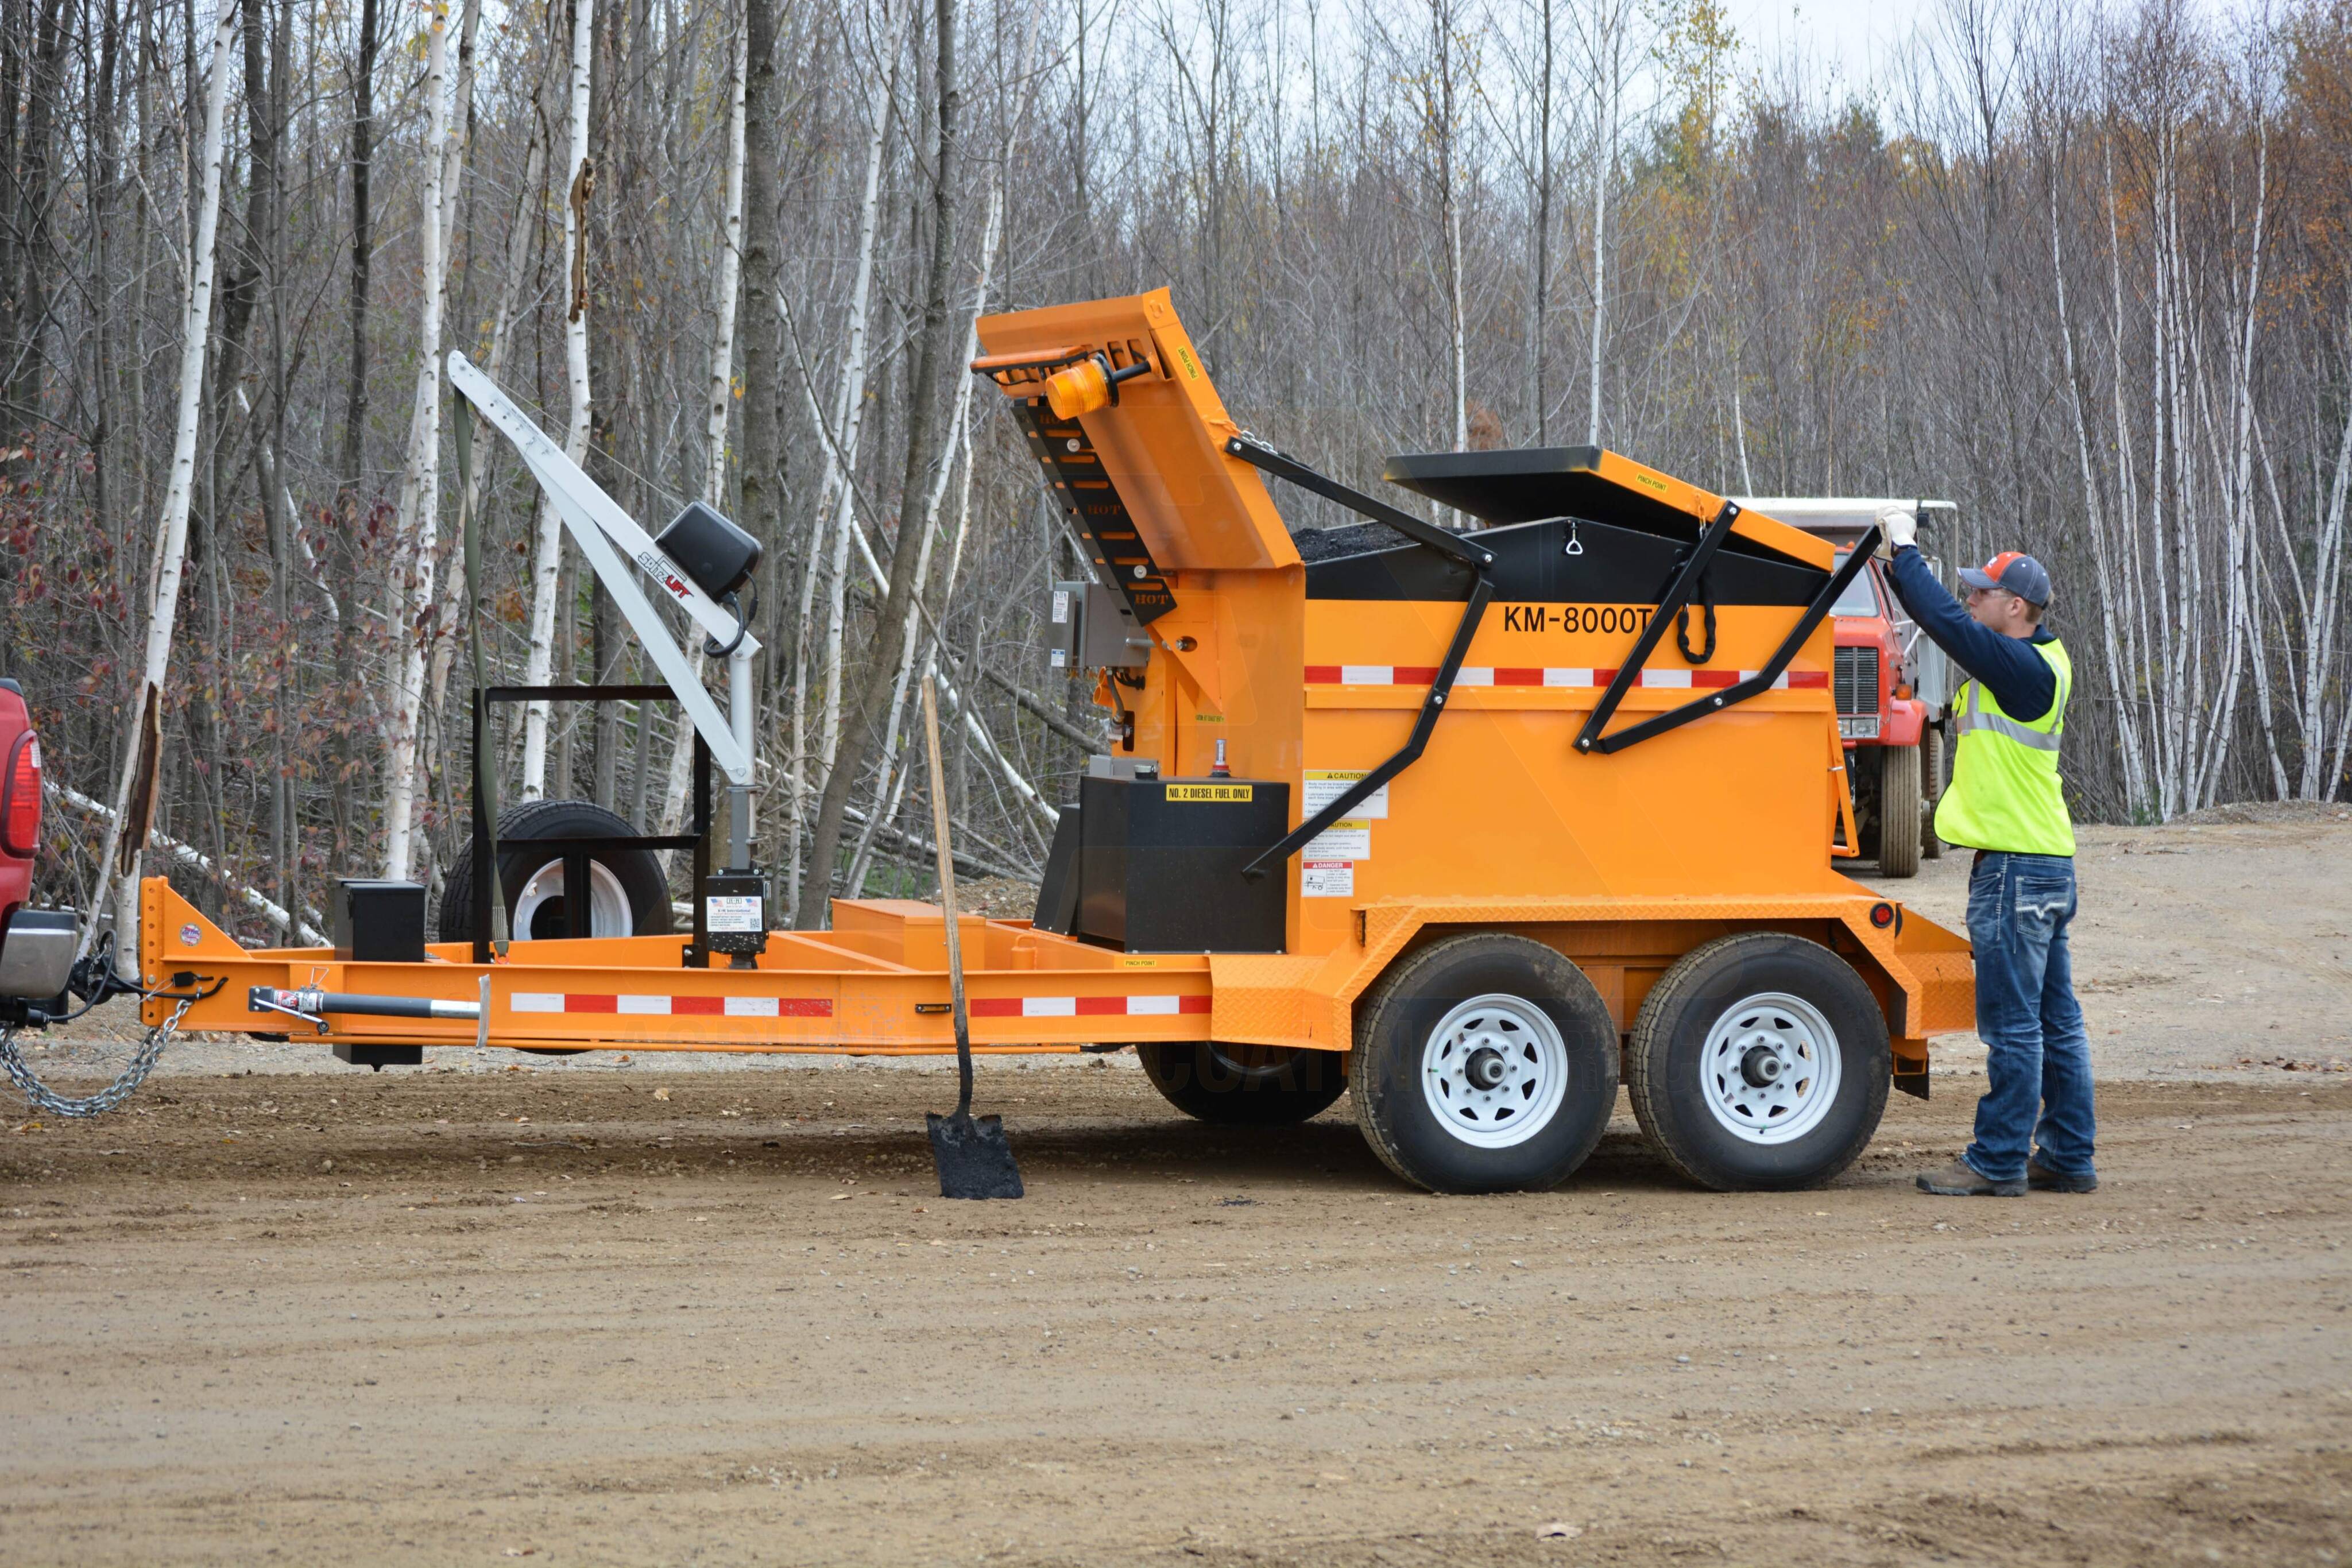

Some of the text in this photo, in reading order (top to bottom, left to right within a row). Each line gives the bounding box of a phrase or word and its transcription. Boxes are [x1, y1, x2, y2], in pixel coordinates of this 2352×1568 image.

[1178, 348, 1198, 379] PINCH POINT
[1637, 474, 1666, 491] PINCH POINT
[1087, 505, 1121, 515] HOT
[1135, 593, 1170, 605] HOT
[1504, 606, 1653, 634] KM-8000T
[1169, 788, 1250, 799] NO. 2 DIESEL FUEL ONLY
